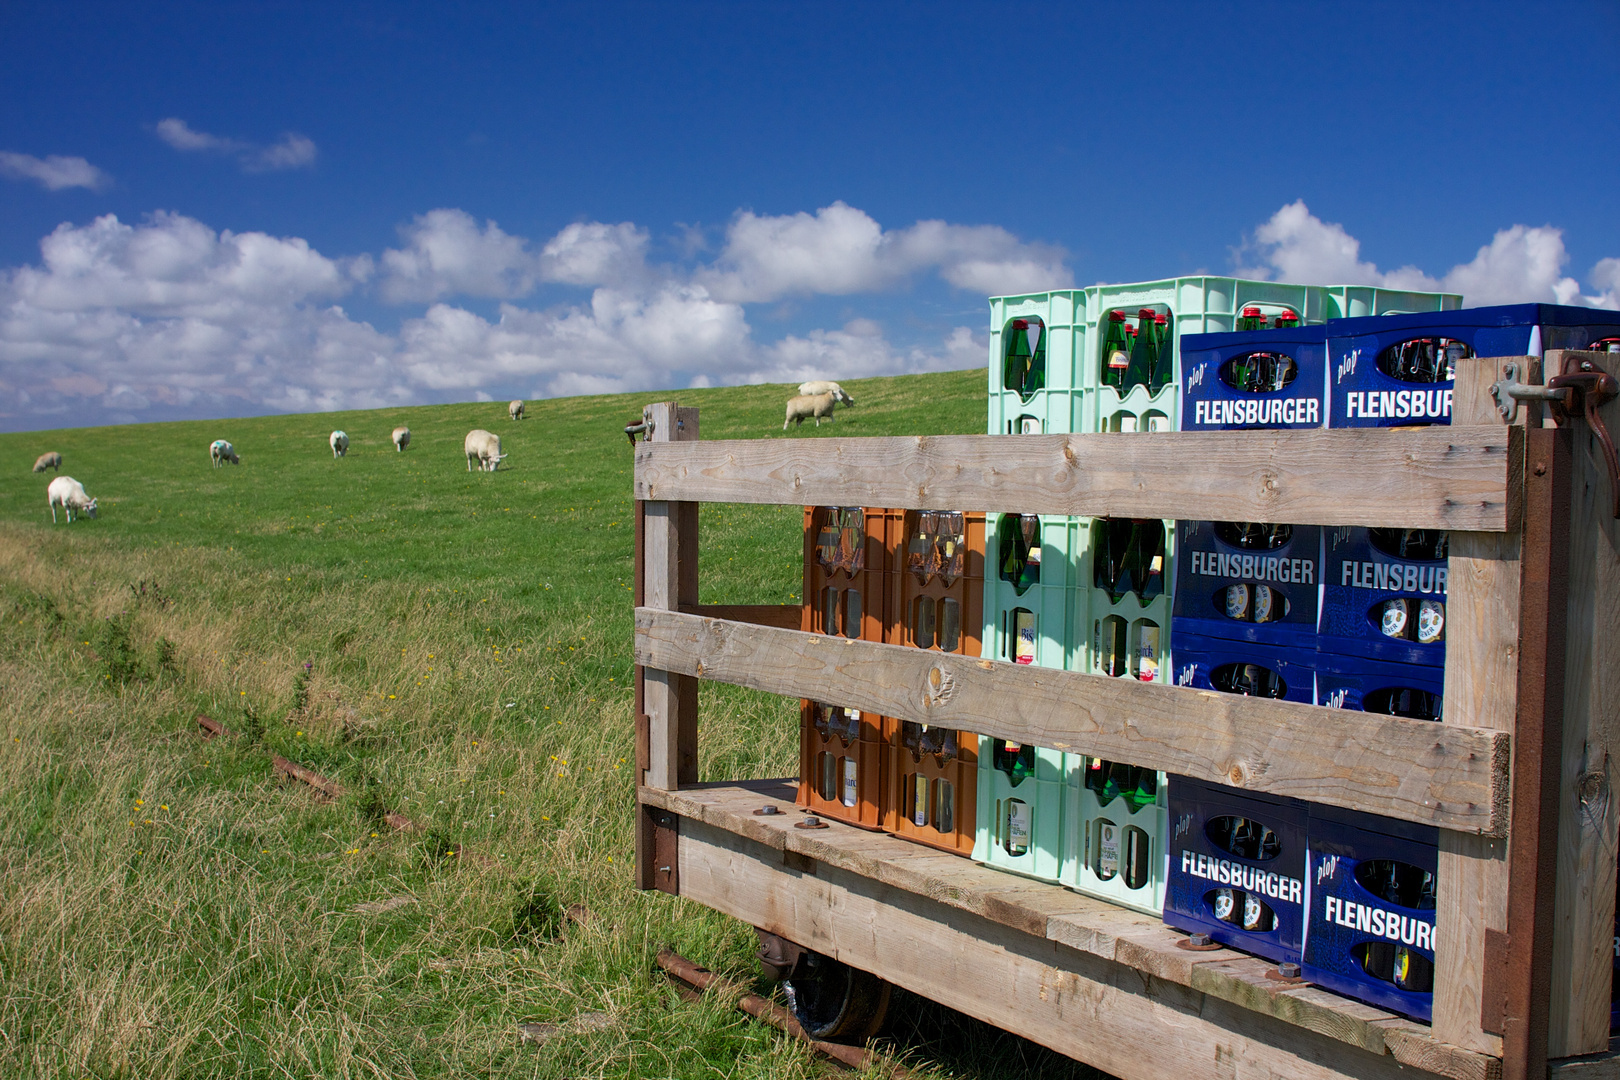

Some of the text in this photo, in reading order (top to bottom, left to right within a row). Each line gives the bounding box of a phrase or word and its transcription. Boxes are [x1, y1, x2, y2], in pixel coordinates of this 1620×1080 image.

[1195, 397, 1319, 425] FLENSBURGER
[1191, 551, 1314, 585] FLENSBURGER
[1182, 849, 1302, 905] FLENSBURGER
